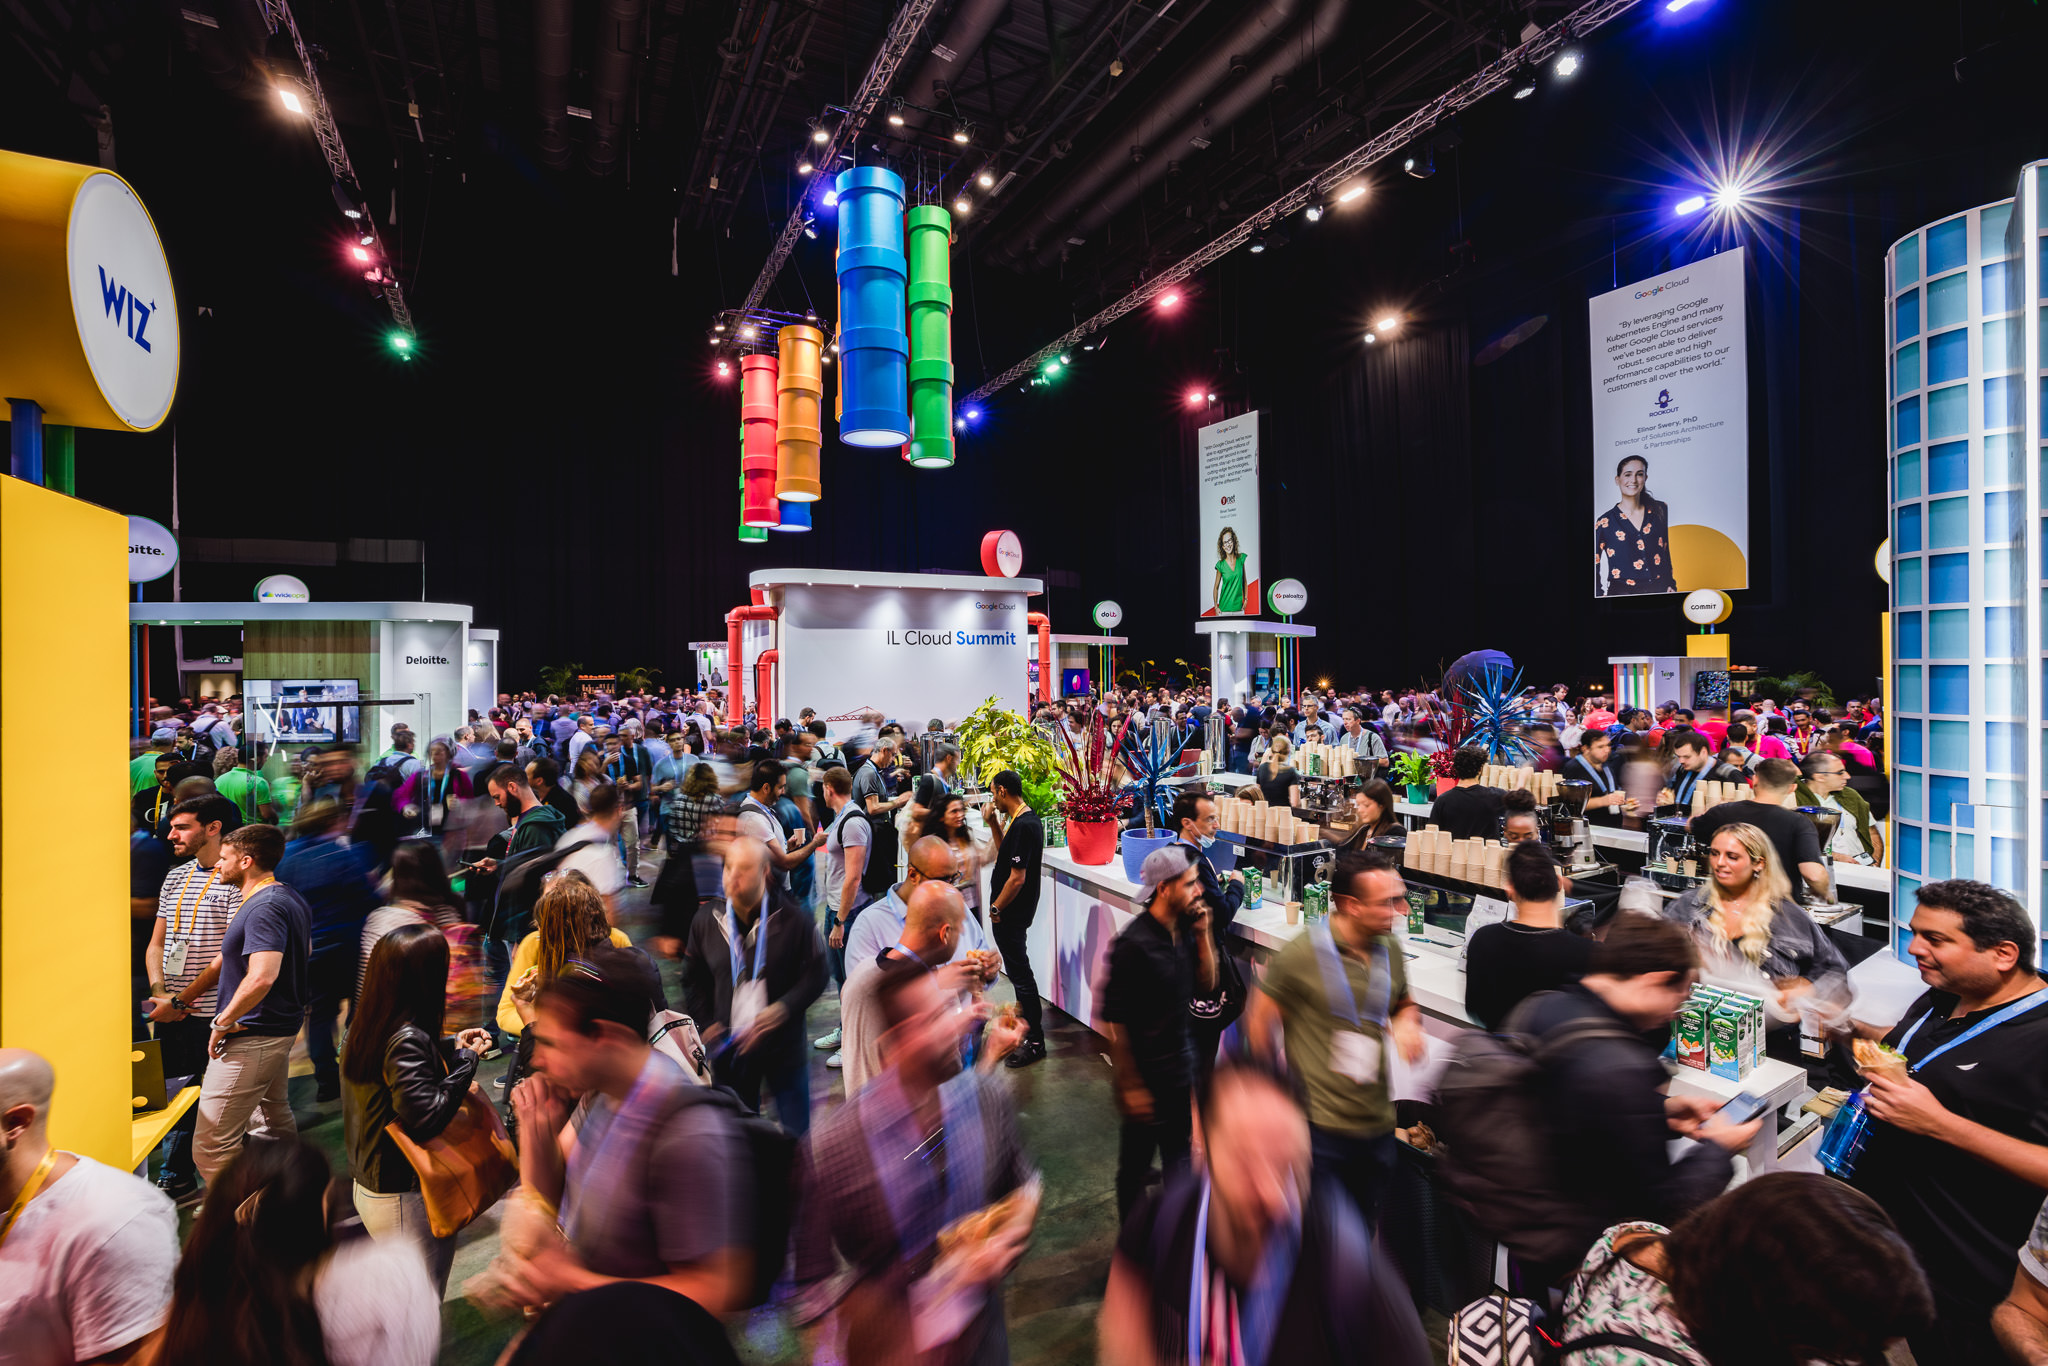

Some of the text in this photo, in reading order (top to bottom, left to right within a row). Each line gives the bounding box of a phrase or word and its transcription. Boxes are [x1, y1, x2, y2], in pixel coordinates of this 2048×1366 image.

[1634, 276, 1690, 299] Google Cloud
[98, 264, 151, 354] WIZ
[1633, 307, 1675, 325] leveraging
[1676, 297, 1709, 312] Google
[1606, 304, 1724, 343] Kubernetes Engine and many
[1607, 315, 1723, 353] other Google Cloud services
[1617, 339, 1712, 370] robust, secure and high
[1636, 345, 1657, 355] been
[1658, 339, 1676, 349] able
[1677, 336, 1687, 344] to
[1687, 327, 1718, 341] deliver
[1603, 346, 1730, 385] performance capabilities to our
[1607, 378, 1647, 393] customers
[1648, 374, 1658, 383] all
[1659, 370, 1678, 380] over
[1679, 366, 1693, 375] the
[1637, 424, 1657, 434] Elinor
[1682, 415, 1698, 424] PhD
[1649, 406, 1679, 418] ROOKOUT
[1614, 420, 1725, 447] Director of Solutions Architecture
[1649, 436, 1692, 449] Partnerships
[975, 601, 1016, 611] Google Cloud
[887, 630, 1017, 645] IL Cloud Summit
[406, 655, 450, 665] Deloitte.
